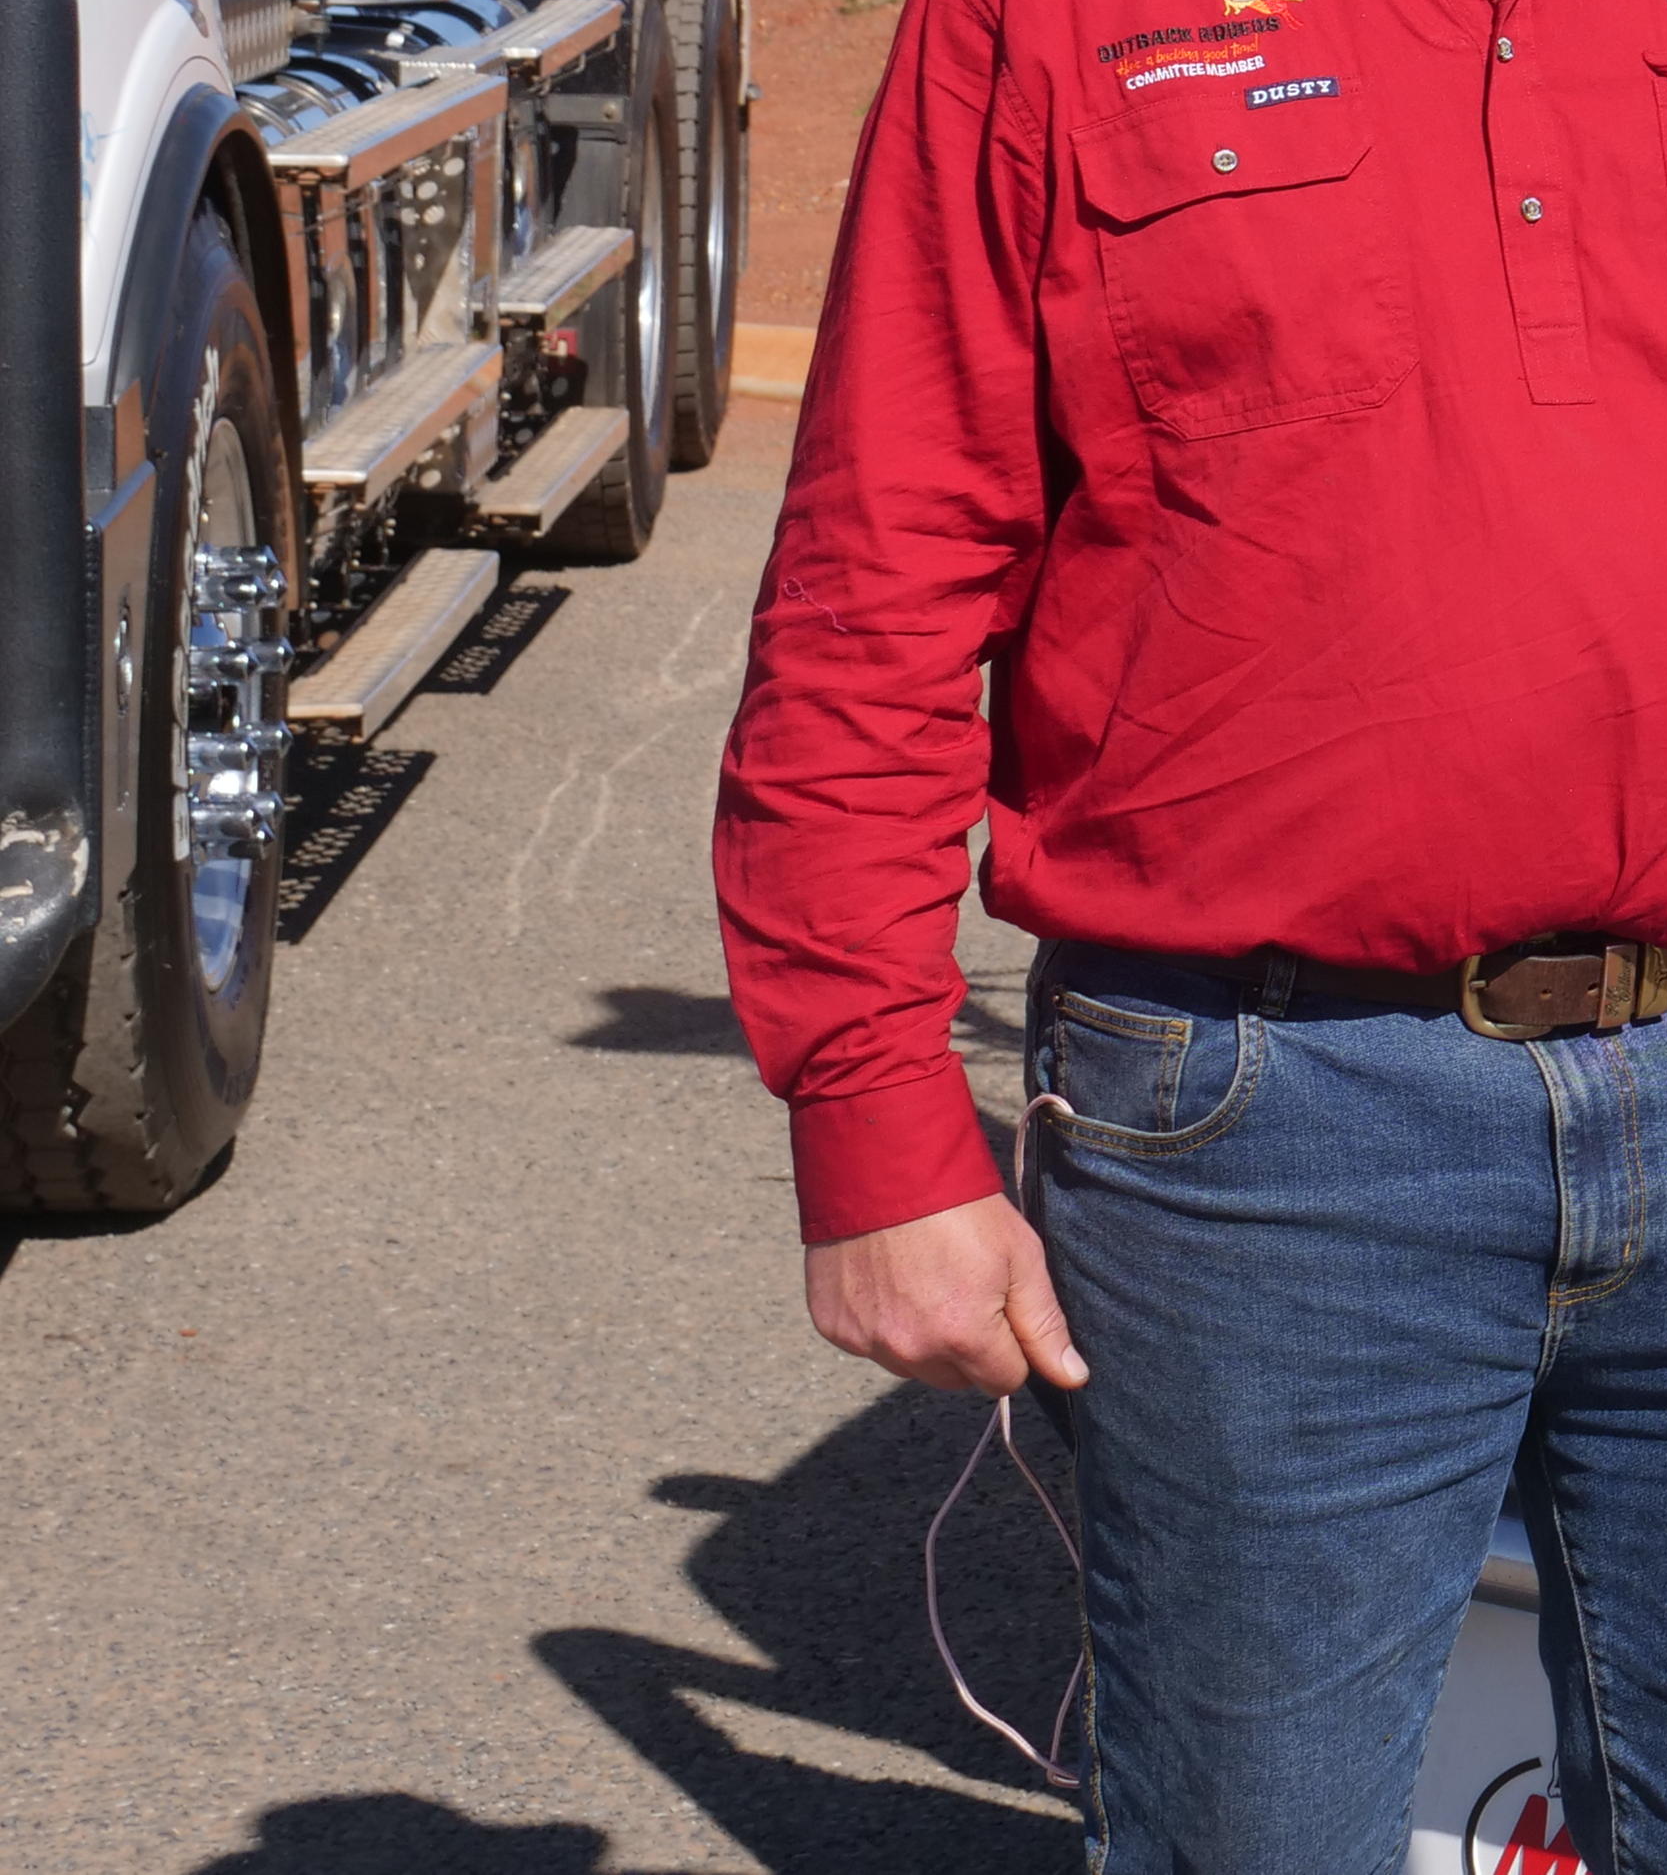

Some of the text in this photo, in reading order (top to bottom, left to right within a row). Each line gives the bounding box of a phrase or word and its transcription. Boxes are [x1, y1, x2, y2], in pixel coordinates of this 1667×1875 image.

[1097, 28, 1193, 63] OUTBACK
[1125, 54, 1266, 90] COMMITTEE MEMBER
[1252, 79, 1333, 105] DUSTY
